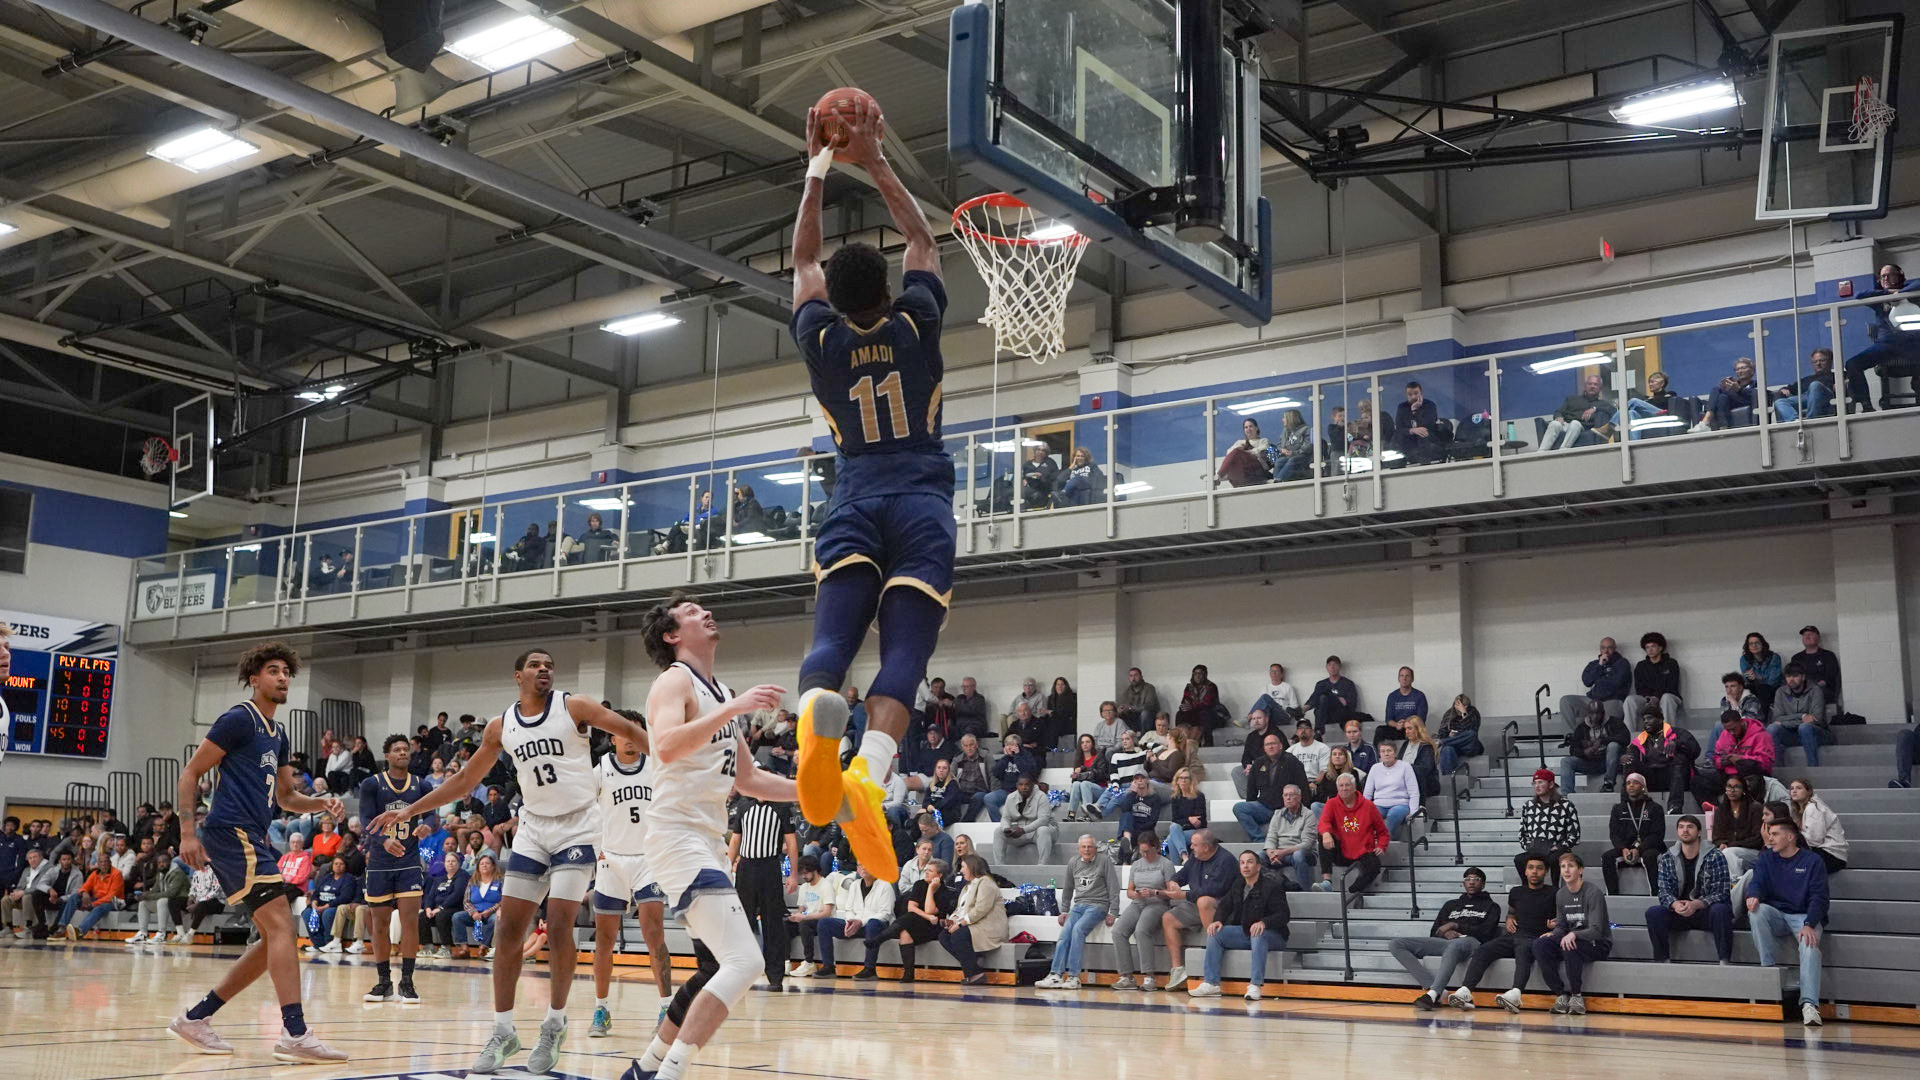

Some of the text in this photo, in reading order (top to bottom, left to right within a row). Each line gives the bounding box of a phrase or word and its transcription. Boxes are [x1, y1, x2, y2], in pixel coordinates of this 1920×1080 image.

[851, 344, 893, 369] AMADI
[849, 370, 910, 443] 11
[163, 594, 205, 609] BLZERS
[9, 622, 50, 639] ZERS
[59, 655, 110, 671] PLY FL PTS
[5, 676, 35, 689] MOUNT
[104, 674, 111, 686] 0
[83, 685, 90, 697] 0
[103, 688, 110, 700] 0
[56, 698, 108, 714] 10 0 6
[15, 714, 37, 723] FOULS
[100, 716, 107, 727] 0
[50, 727, 105, 742] 45 0 2
[15, 743, 31, 752] WON
[77, 743, 84, 753] 4
[513, 738, 564, 763] HOOD
[533, 763, 557, 787] 13
[612, 785, 652, 806] HOOD
[630, 806, 640, 824] 5
[383, 820, 410, 840] 45
